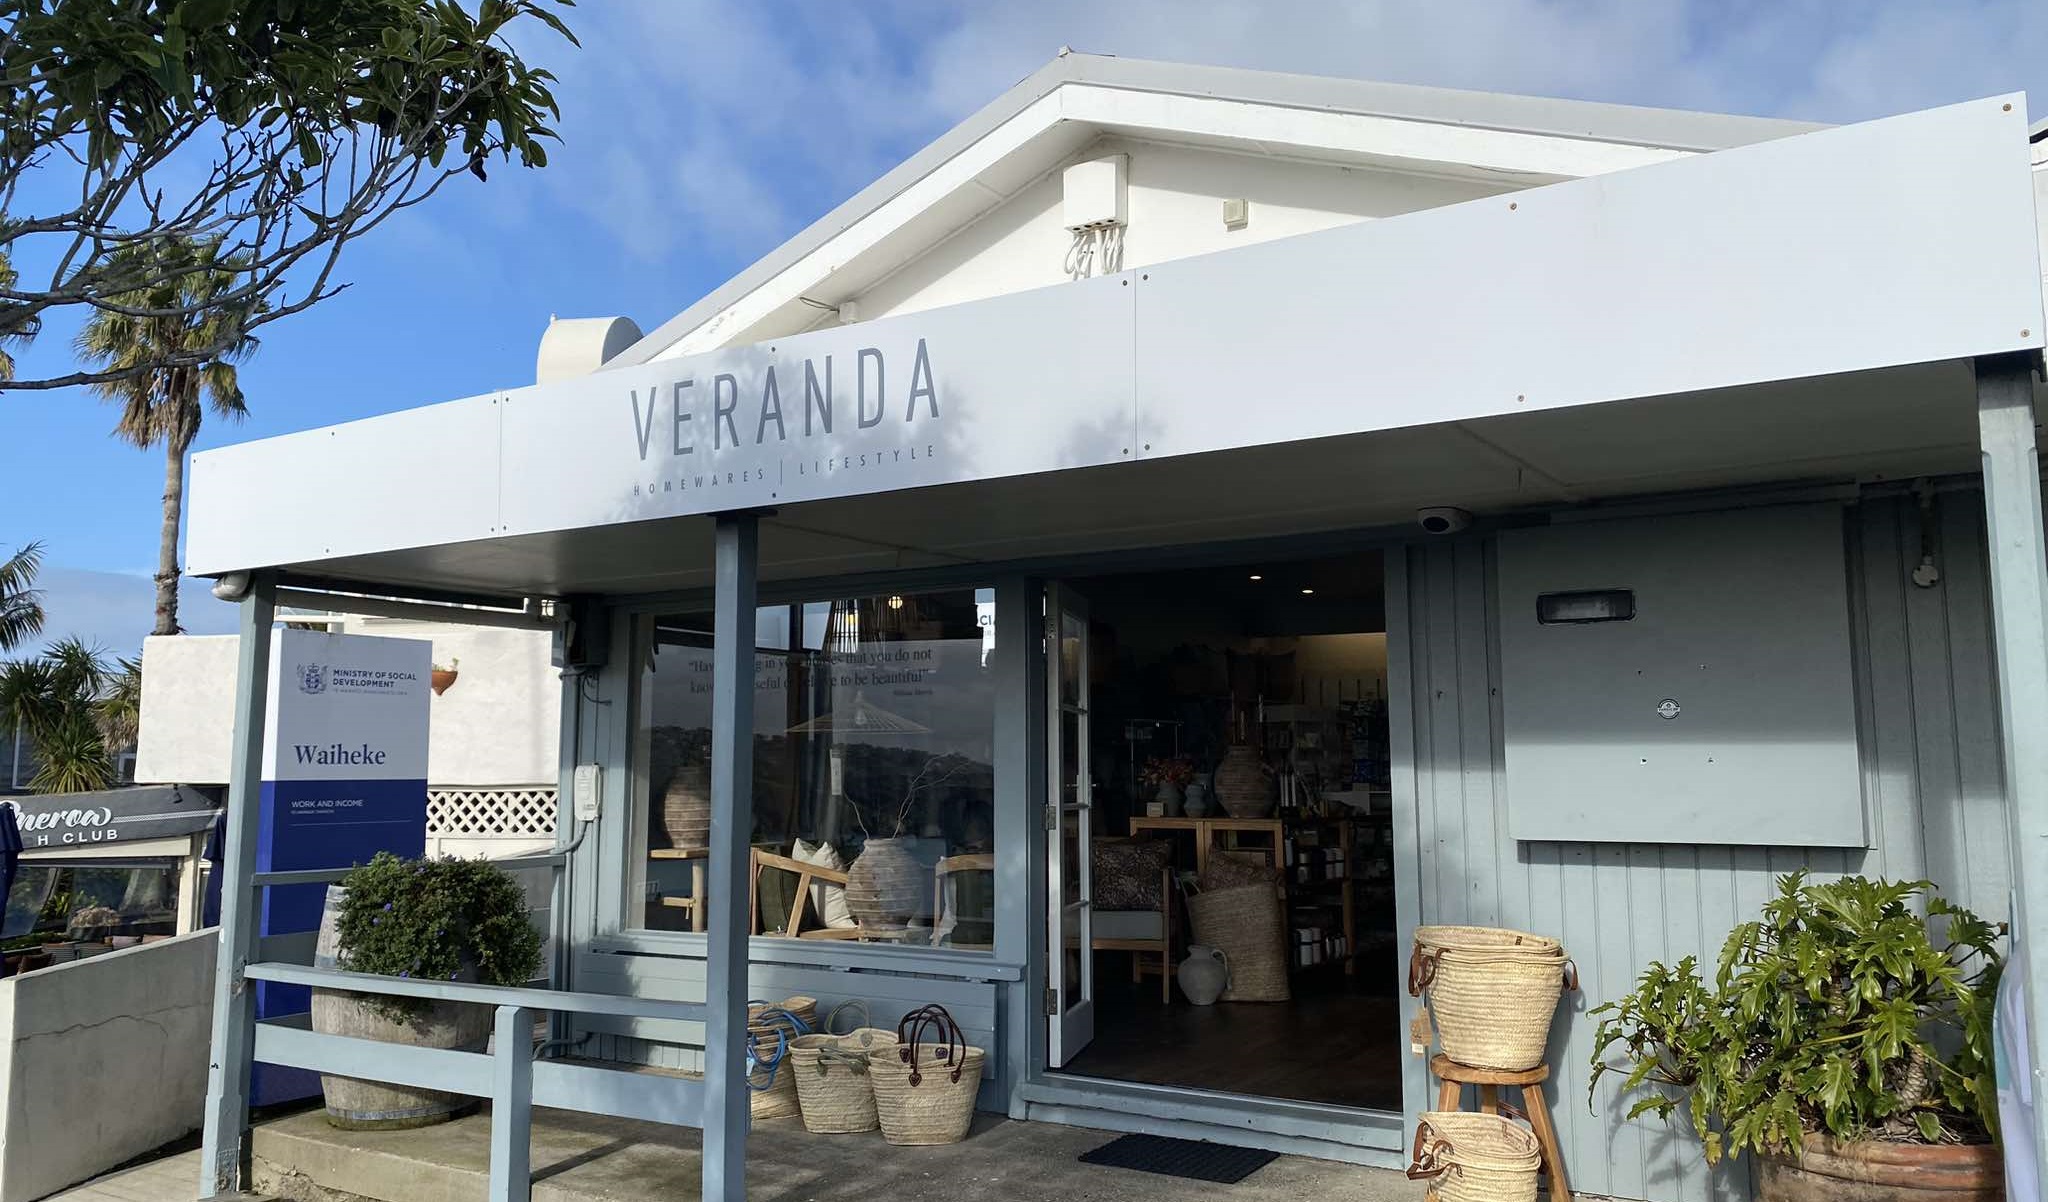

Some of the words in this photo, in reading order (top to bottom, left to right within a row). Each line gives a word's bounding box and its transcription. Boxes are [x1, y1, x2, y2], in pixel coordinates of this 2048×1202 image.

[631, 338, 940, 461] VERANDA
[633, 468, 764, 496] HOMEWARES
[799, 445, 936, 475] LIFESTYLE
[846, 652, 867, 664] that
[868, 653, 892, 666] you
[895, 648, 910, 662] do
[913, 648, 931, 661] not
[333, 669, 373, 678] MINISTRY
[375, 671, 387, 679] OF
[388, 672, 417, 681] SOCIAL
[333, 678, 395, 688] DEVELOPMENT
[840, 674, 852, 687] to
[854, 671, 868, 686] be
[294, 744, 386, 765] Waiheke
[291, 800, 316, 808] WORK
[317, 800, 334, 808] AND
[335, 799, 364, 807] INCOME
[0, 800, 112, 831] neroa
[62, 829, 118, 843] CLUB
